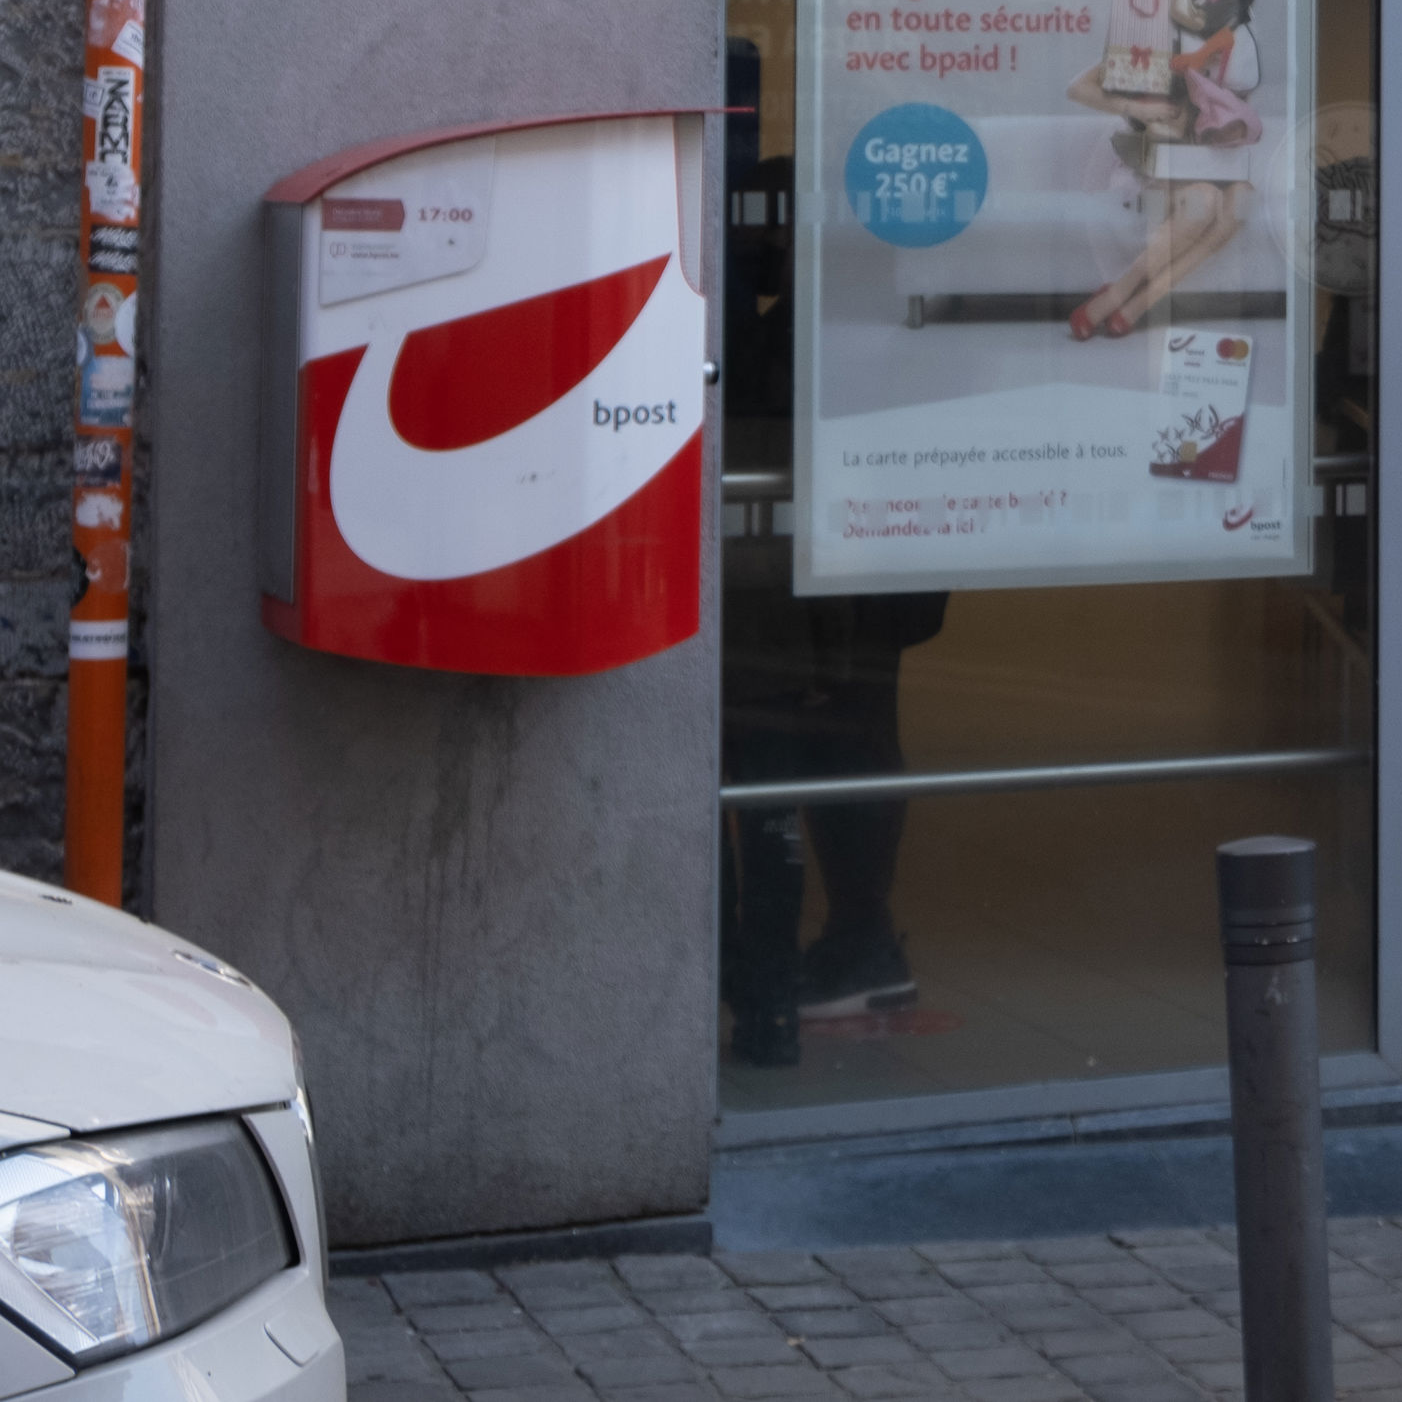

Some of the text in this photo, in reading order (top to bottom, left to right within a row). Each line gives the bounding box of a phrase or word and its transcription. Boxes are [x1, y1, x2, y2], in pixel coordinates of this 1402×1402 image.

[846, 4, 1092, 34] en toute sécurité
[846, 42, 1017, 79] avec bpaid !
[864, 137, 969, 171] Gagnez
[418, 208, 473, 223] 17:00
[593, 398, 677, 433] bpost
[843, 443, 1128, 470] La carte prépayée accessible à tous.
[1250, 518, 1282, 533] bpost
